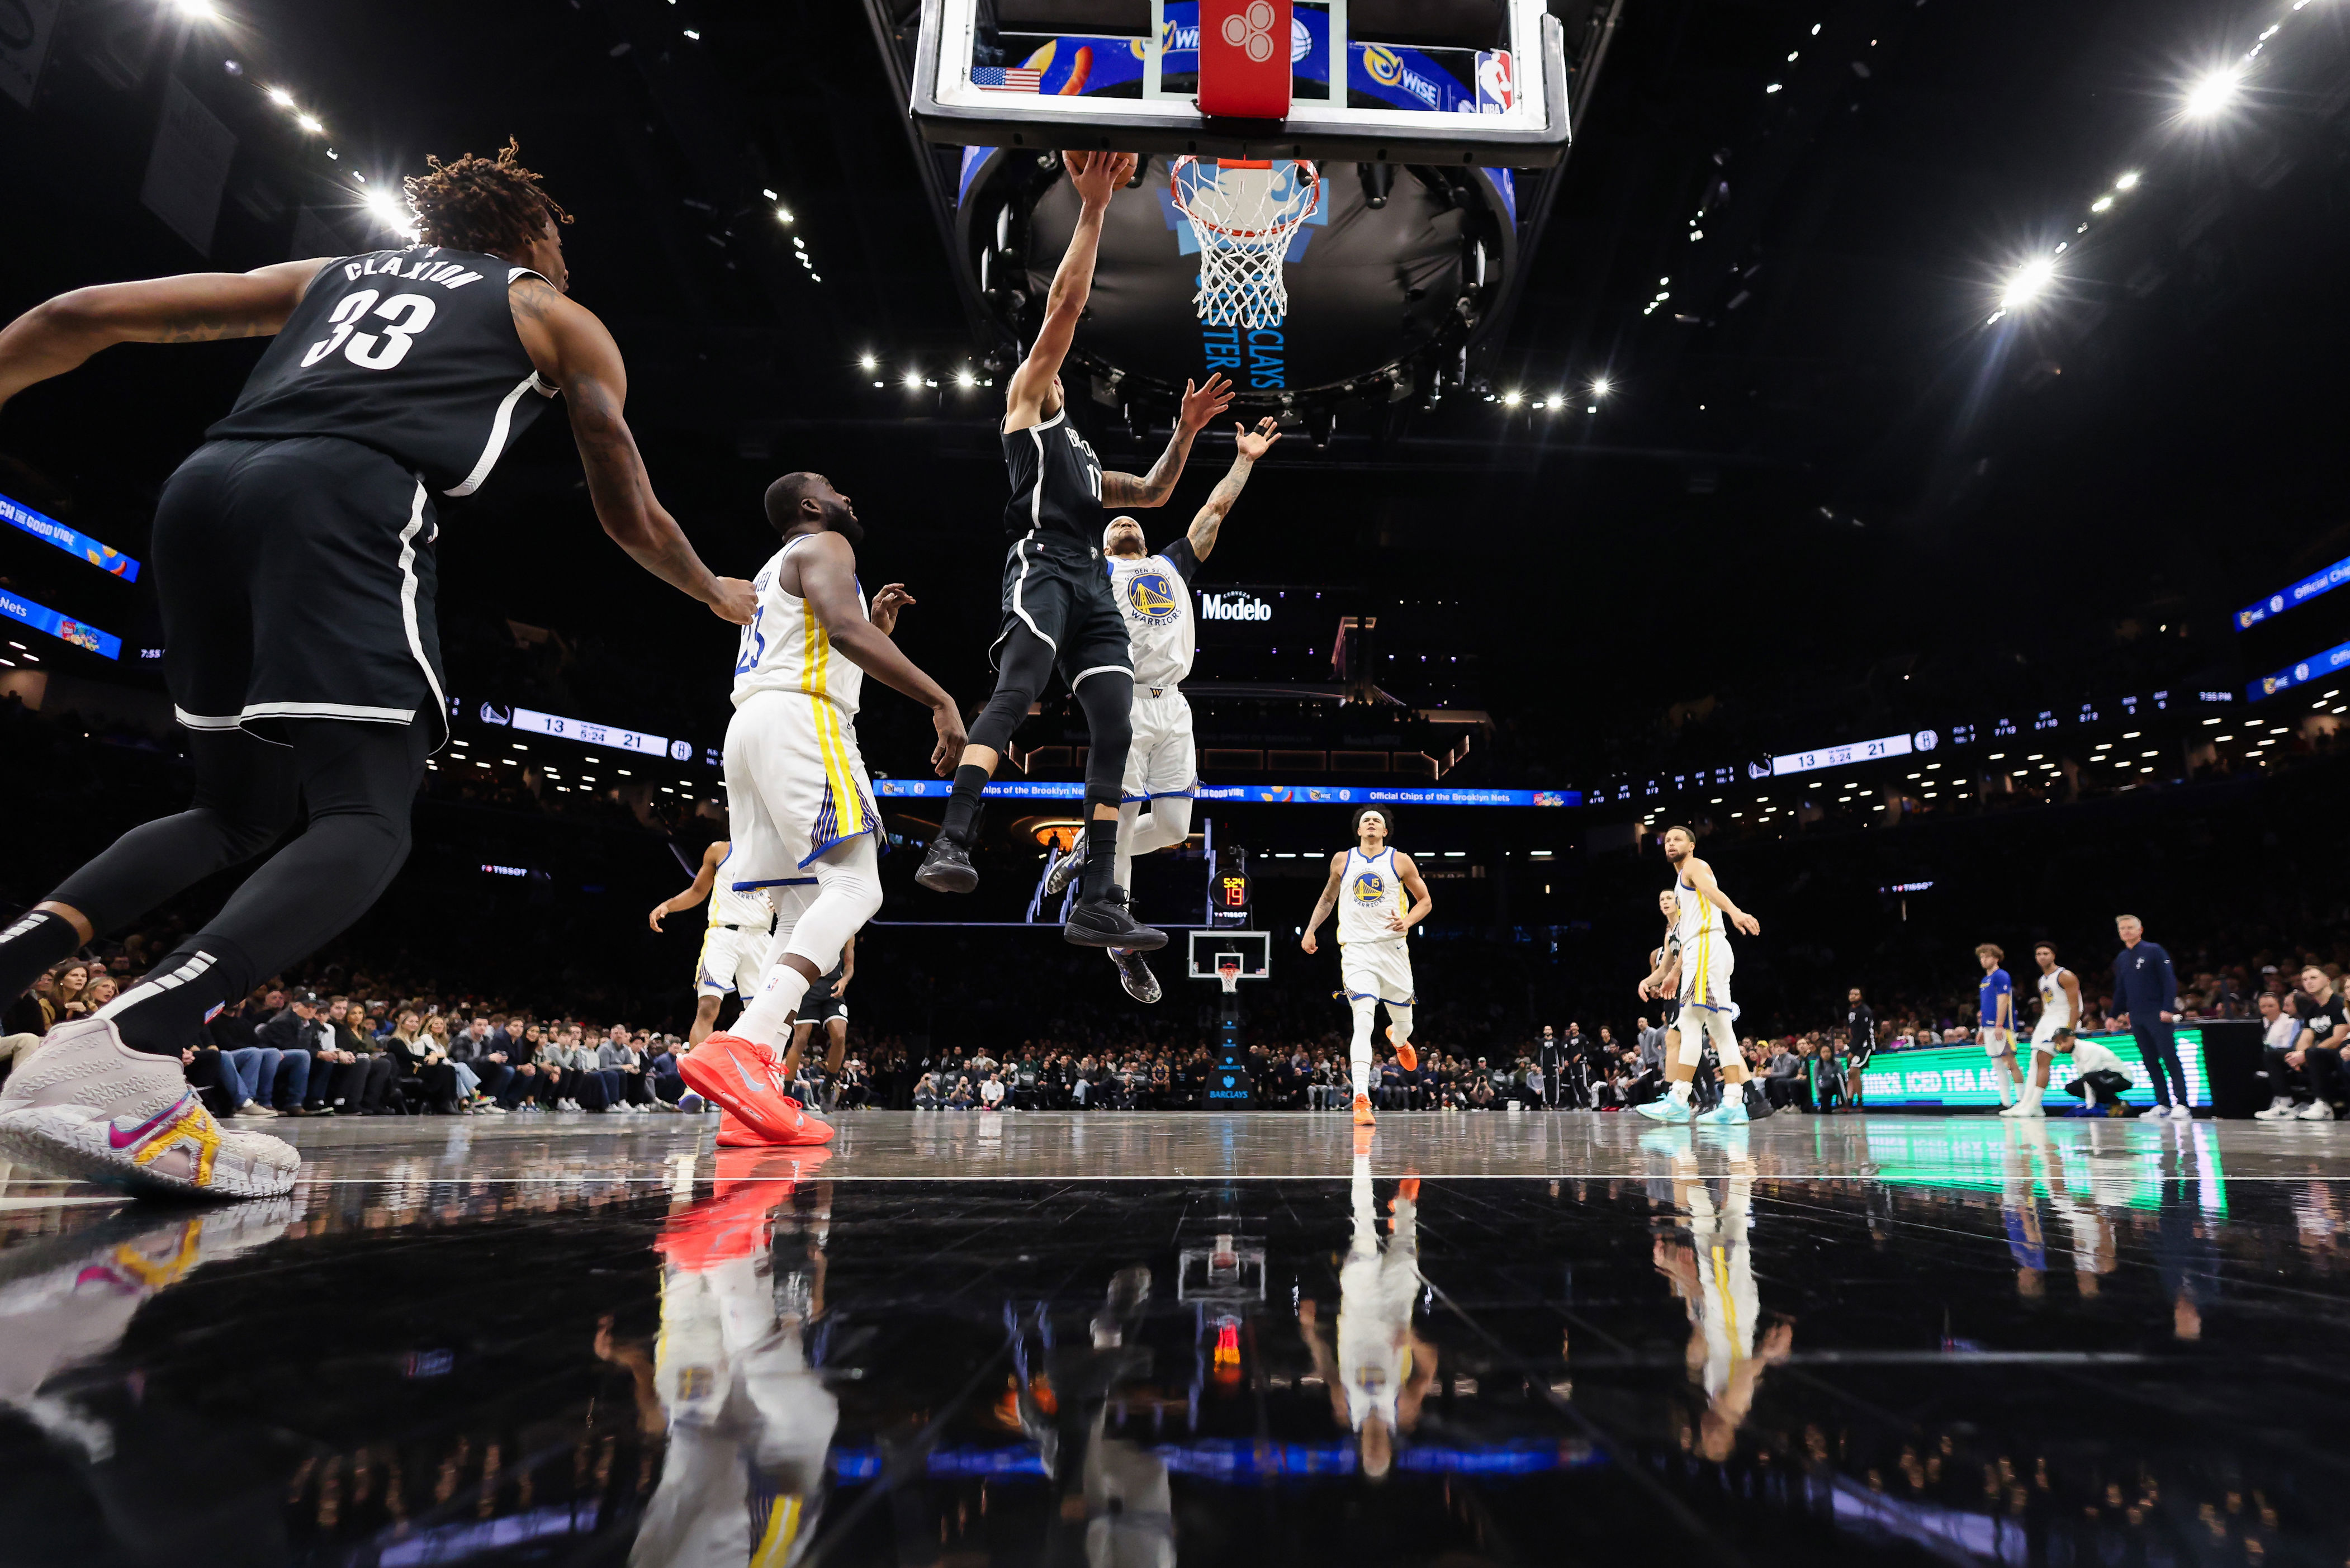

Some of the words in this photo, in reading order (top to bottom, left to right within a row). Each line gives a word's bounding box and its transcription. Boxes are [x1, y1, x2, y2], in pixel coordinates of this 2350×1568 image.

[1176, 29, 1199, 49] WI
[1403, 69, 1436, 106] WISE
[1482, 103, 1501, 114] NBA
[344, 257, 484, 290] CLAXTON
[301, 289, 436, 370] 33
[26, 515, 53, 536] GOOD
[1125, 568, 1148, 581] GOLDEN
[1158, 581, 1167, 594] 0
[0, 596, 27, 617] Nets
[1202, 594, 1272, 621] Modelo
[1131, 608, 1182, 626] WARRIORS
[544, 718, 564, 733] 13
[623, 733, 641, 749] 21
[1868, 742, 1885, 756] 21
[1798, 755, 1815, 768] 13
[982, 786, 1001, 794] hips
[1031, 786, 1069, 795] Brooklyn
[1209, 789, 1228, 798] GOOD
[1228, 788, 1244, 797] VIBE
[1370, 792, 1398, 800] Official
[1400, 792, 1423, 801] Chips
[1452, 793, 1489, 802] Brooklyn
[493, 865, 527, 877] TISSOT
[1223, 878, 1245, 888] 5:24
[1371, 878, 1380, 888] 15
[1226, 888, 1243, 906] 19
[1353, 896, 1386, 908] WARRIORS
[1906, 1070, 1941, 1093] ICED
[1942, 1069, 1977, 1092] TEA
[1209, 1091, 1248, 1099] BARCLAYS
